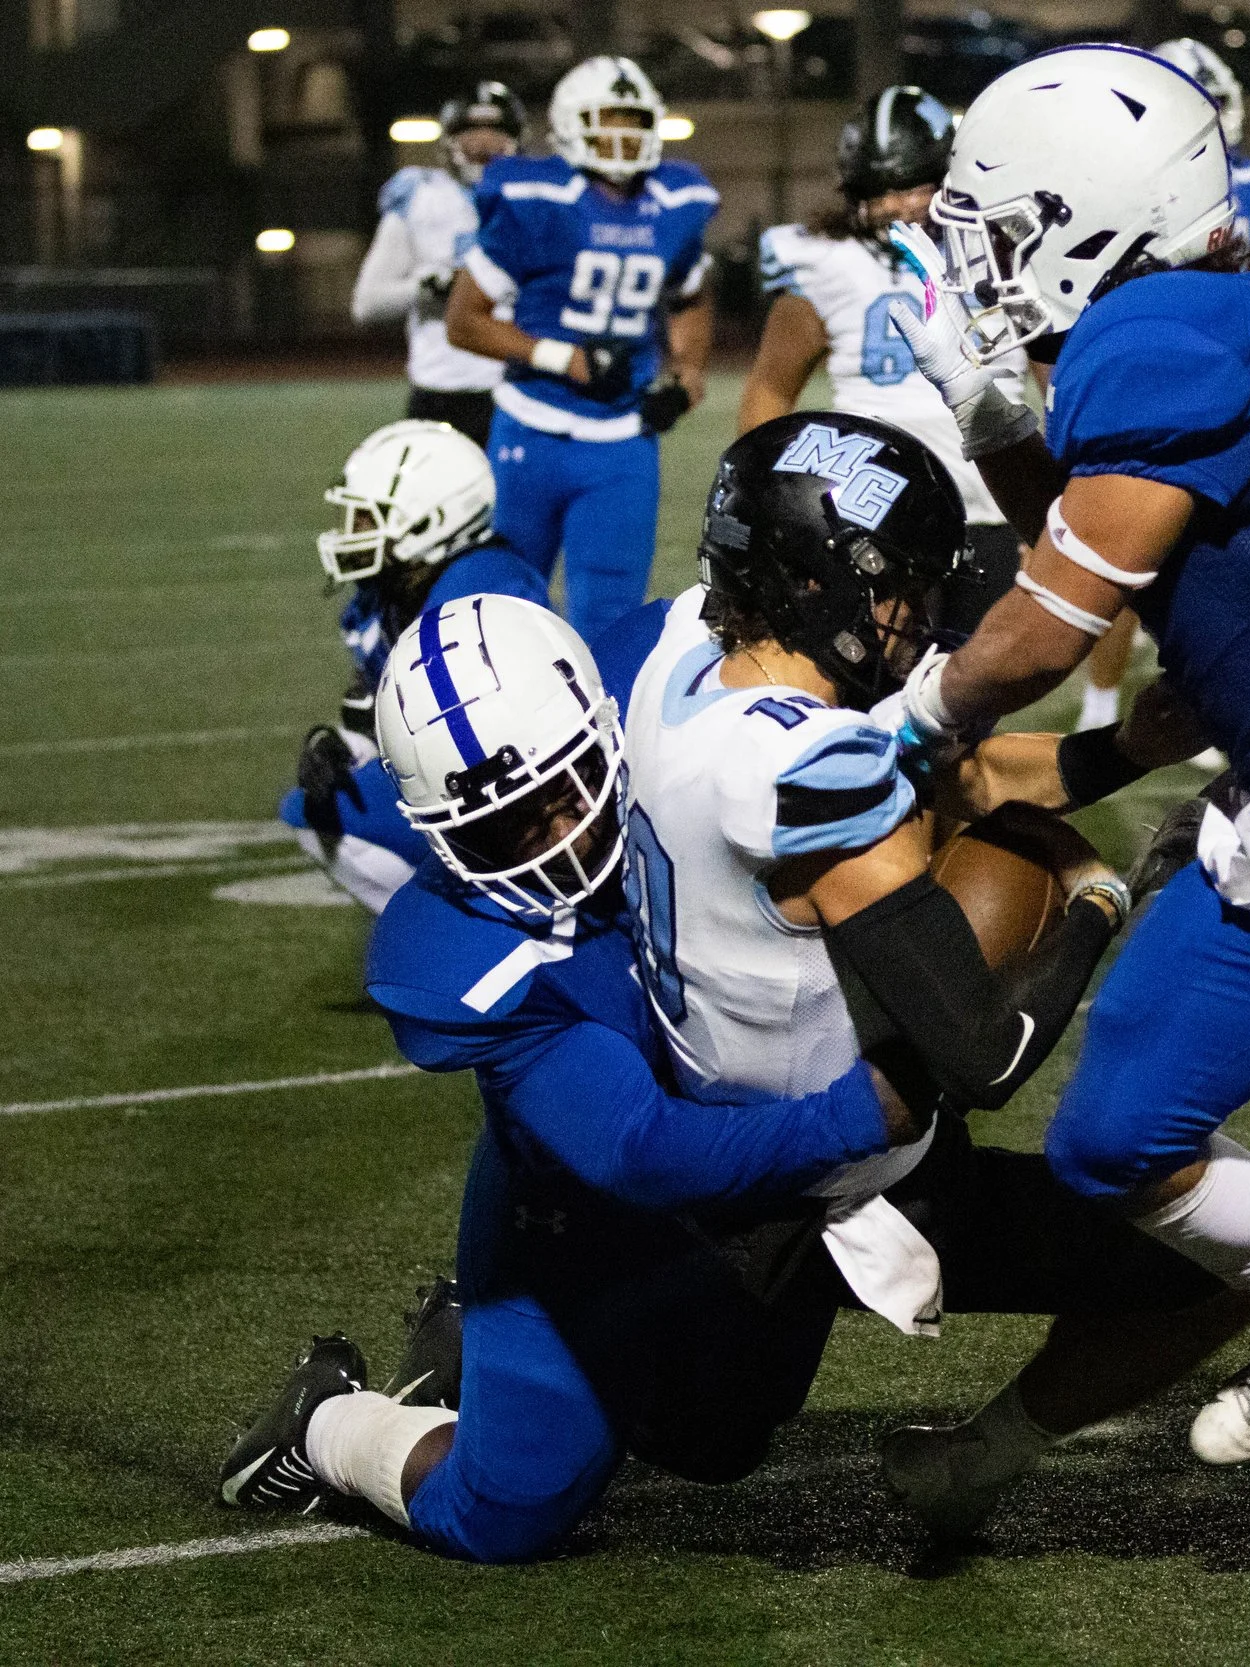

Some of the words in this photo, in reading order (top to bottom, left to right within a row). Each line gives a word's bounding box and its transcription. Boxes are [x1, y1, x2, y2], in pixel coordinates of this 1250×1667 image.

[561, 250, 664, 336] 99
[772, 423, 910, 532] MC
[743, 696, 826, 731] 1
